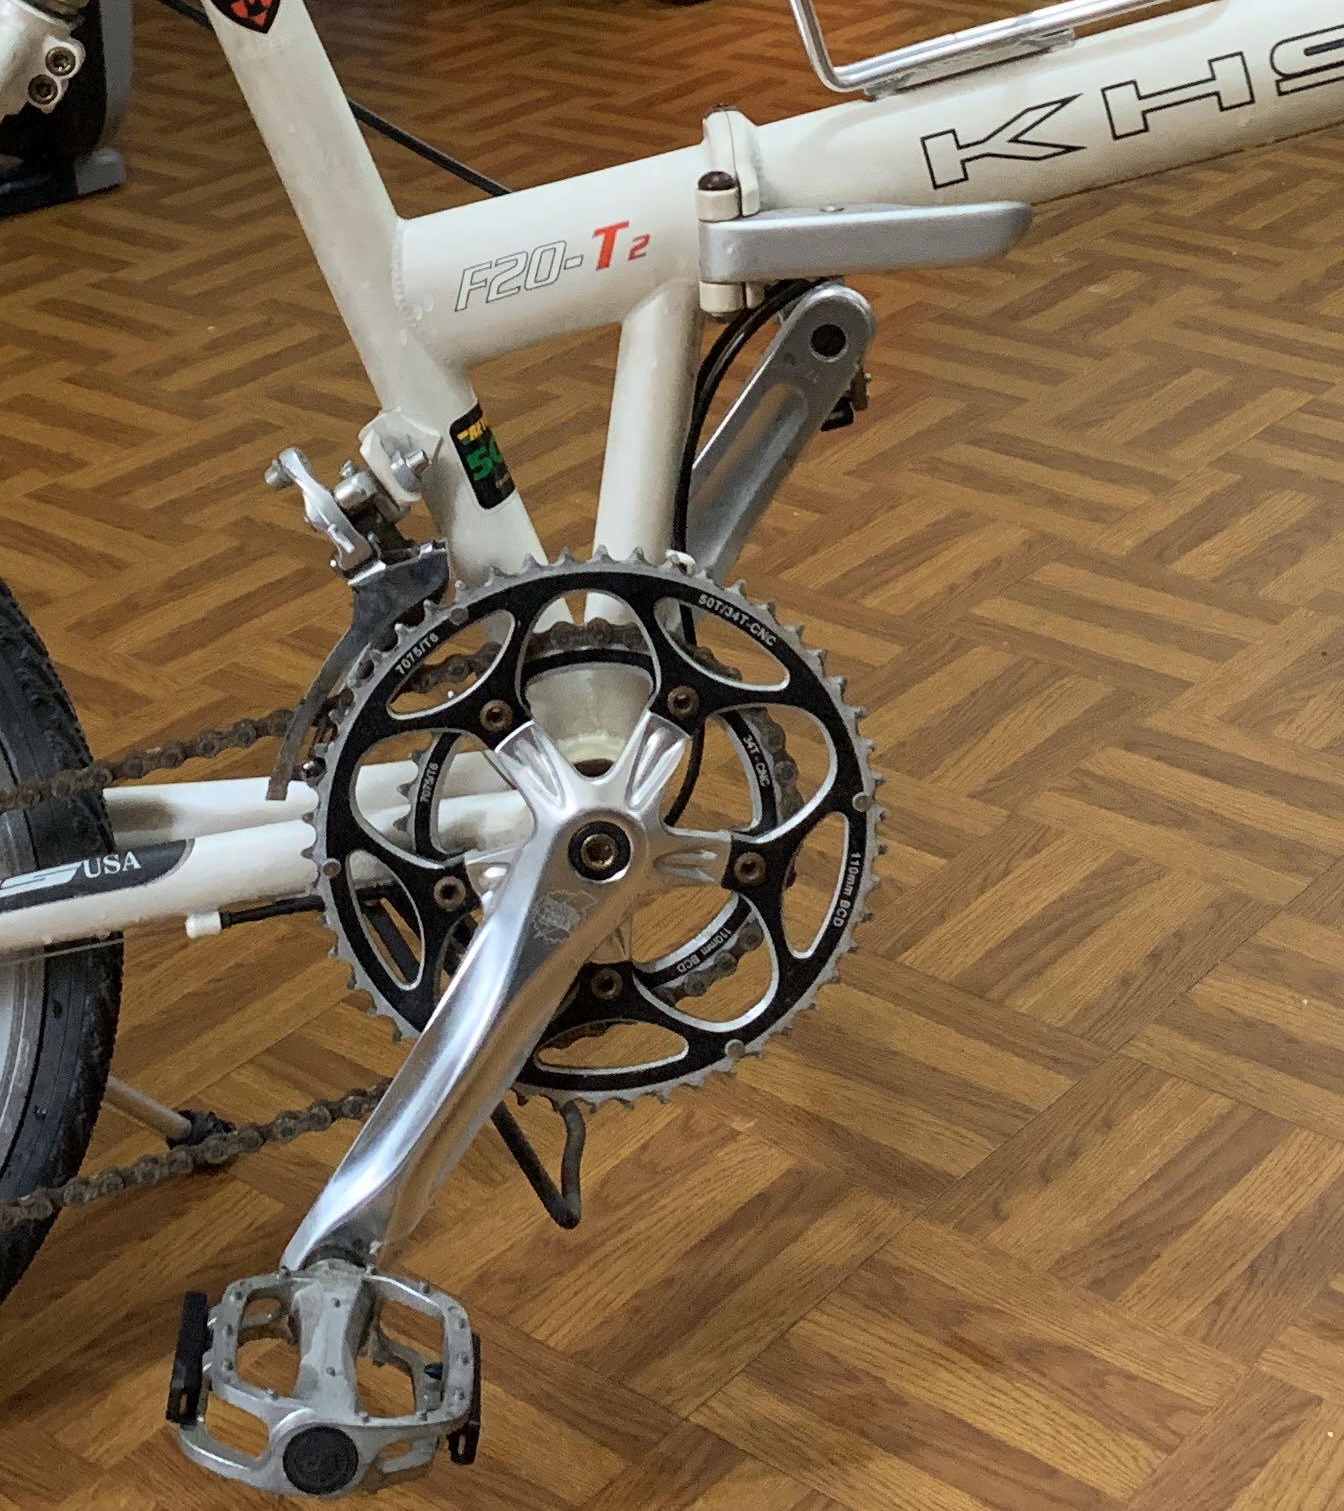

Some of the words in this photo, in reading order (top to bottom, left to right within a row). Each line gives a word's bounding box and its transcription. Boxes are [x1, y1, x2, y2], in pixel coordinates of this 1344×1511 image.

[698, 593, 777, 646] 50T/34T-CNC
[394, 632, 440, 675] 7075/T6
[83, 849, 142, 880] USA
[842, 852, 862, 896] 110mm
[832, 899, 851, 928] BCD
[699, 927, 733, 956] 110mm
[676, 953, 702, 974] BCD
